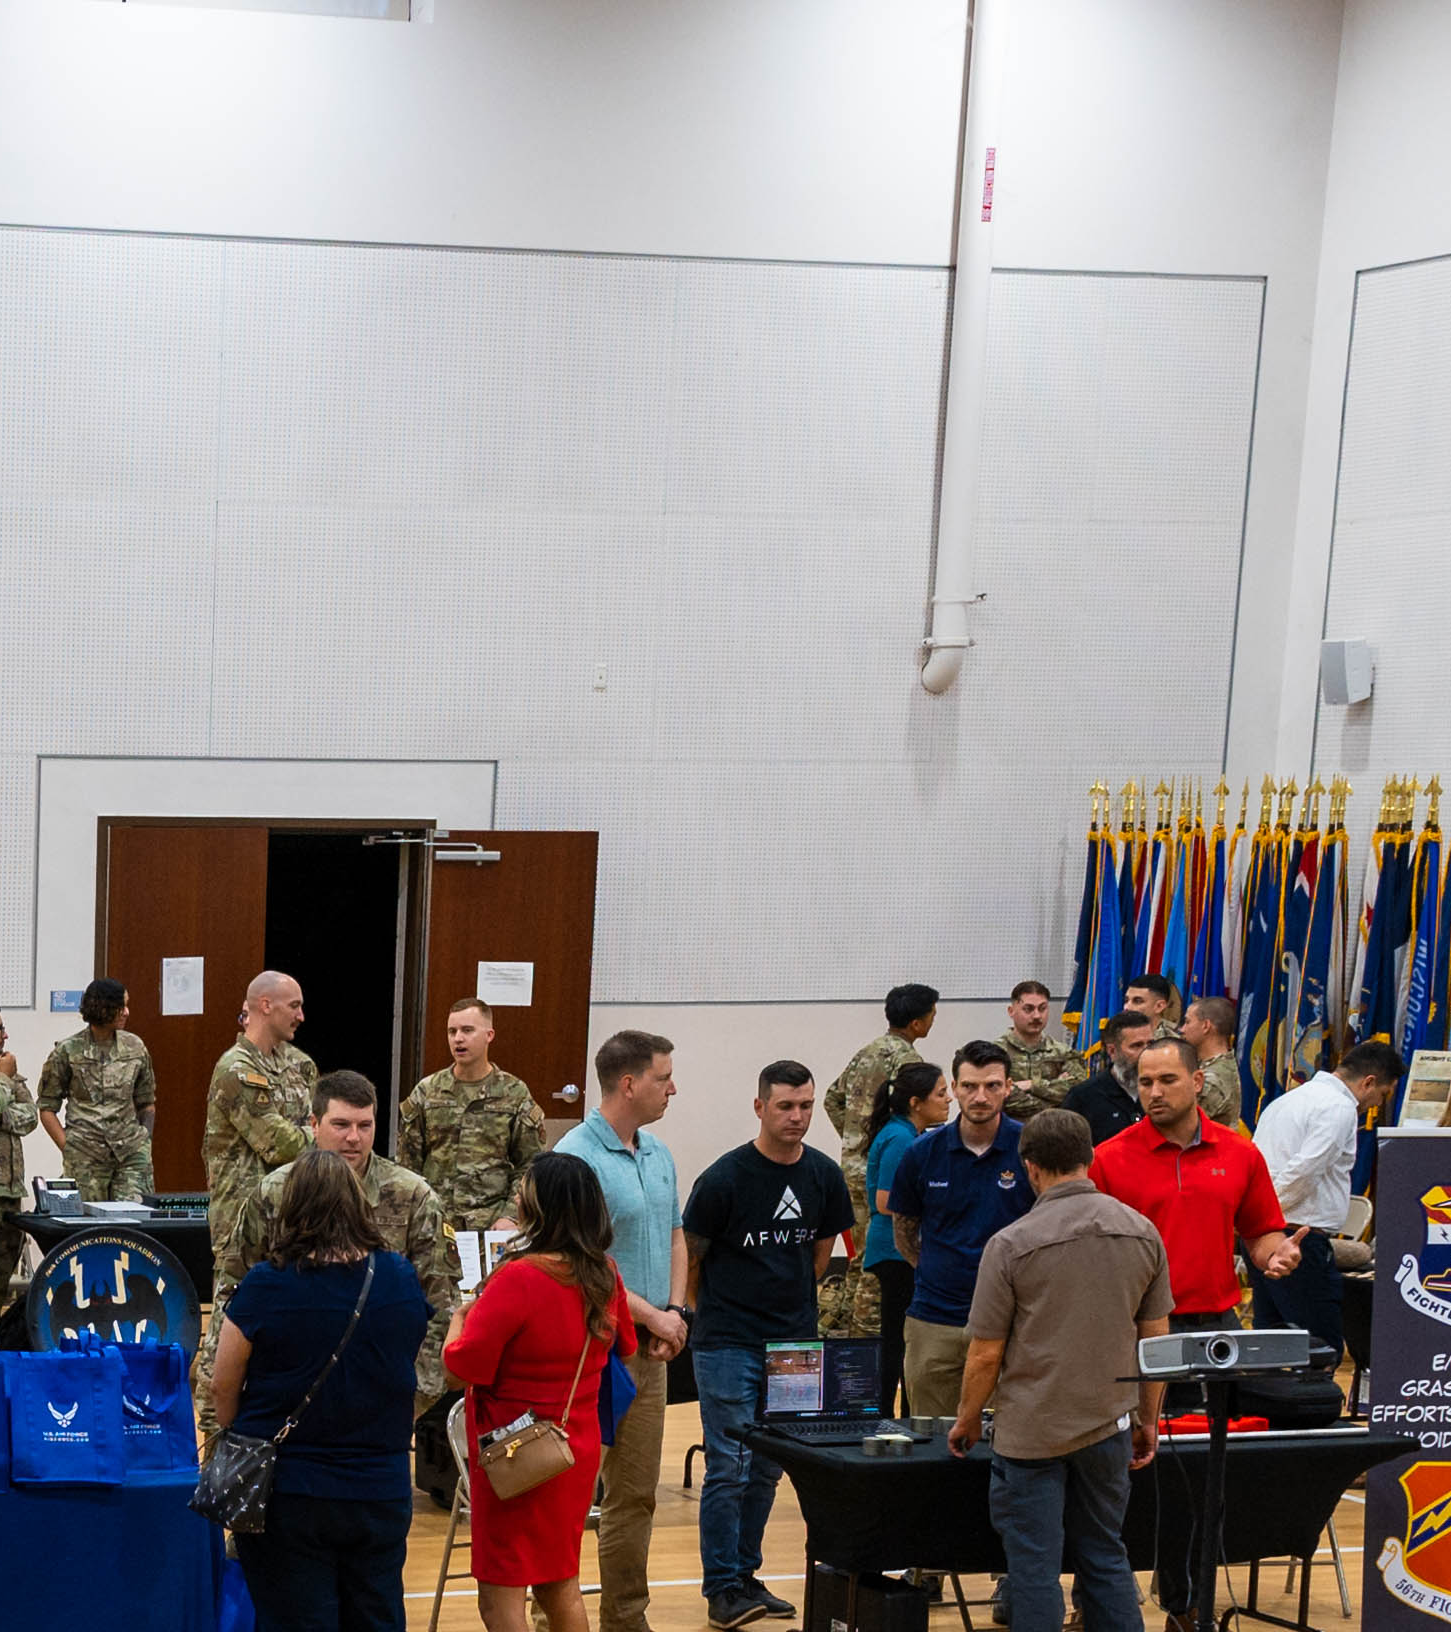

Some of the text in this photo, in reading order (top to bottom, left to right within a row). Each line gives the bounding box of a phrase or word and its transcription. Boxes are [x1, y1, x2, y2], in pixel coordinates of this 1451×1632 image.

[55, 1236, 122, 1265] COMMUNICATIONS
[123, 1239, 163, 1267] SQUADRON
[1395, 1579, 1426, 1603] 56TH
